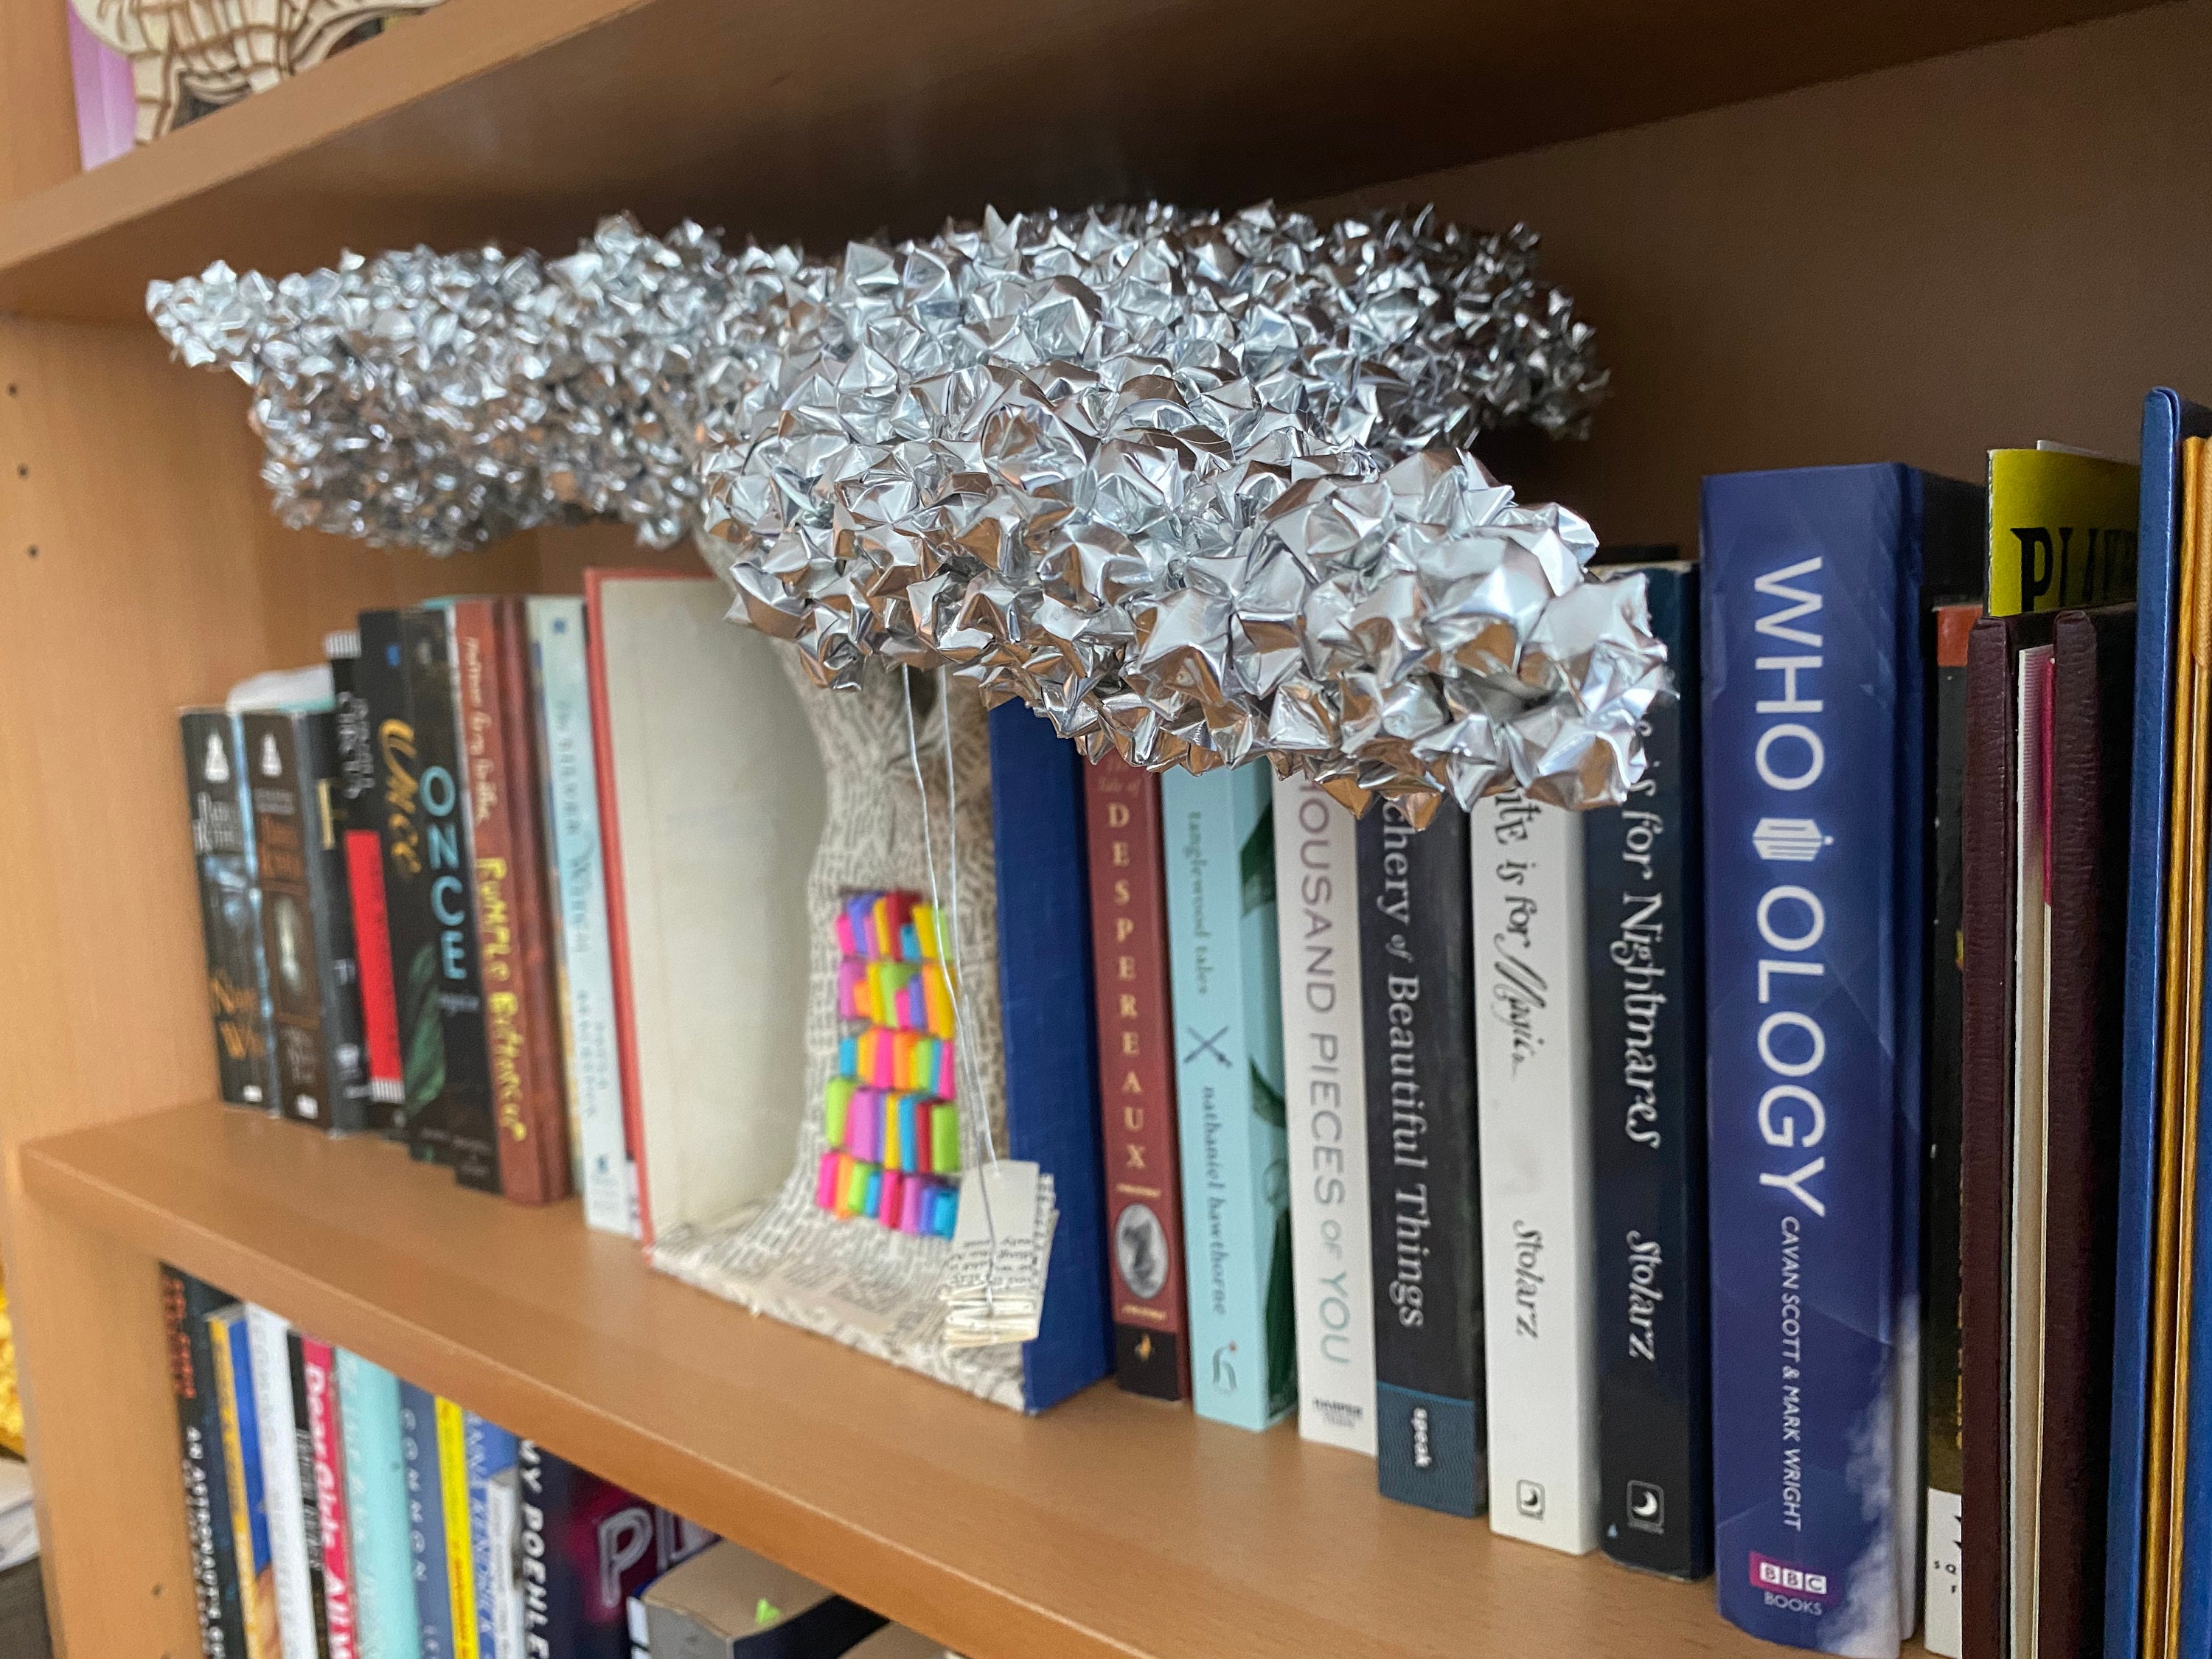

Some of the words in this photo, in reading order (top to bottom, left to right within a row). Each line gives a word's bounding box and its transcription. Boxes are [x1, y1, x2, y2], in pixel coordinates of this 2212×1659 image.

[1754, 555, 1825, 791] WHO
[419, 765, 467, 981] ONCE
[1181, 811, 1212, 938] tanglewood
[1496, 860, 1529, 886] is
[1623, 810, 1664, 880] for
[1385, 933, 1413, 964] of
[1504, 895, 1538, 949] for
[1107, 801, 1147, 1169] DESPEREAUX
[1194, 945, 1215, 994] tales
[1610, 892, 1666, 1150] Nightmares
[1755, 885, 1827, 1218] OLOGY
[1388, 973, 1429, 1169] Beautiful
[1202, 1085, 1226, 1188] nathaniel
[1308, 1032, 1346, 1206] PIECES
[1205, 1190, 1228, 1314] hawthorne
[1320, 1218, 1342, 1259] OF
[1388, 1183, 1430, 1328] Things
[1512, 1219, 1545, 1340] Stolarz
[1780, 1215, 1800, 1290] CAVAN
[1318, 1271, 1352, 1365] YOU
[1627, 1230, 1663, 1363] Stolarz
[1781, 1295, 1801, 1364] SCOTT
[1782, 1366, 1801, 1380] &
[1782, 1385, 1801, 1443] MARK
[1781, 1448, 1801, 1531] WRIGHT
[1759, 1562, 1827, 1595] BBC
[1764, 1592, 1822, 1615] BOOKS
